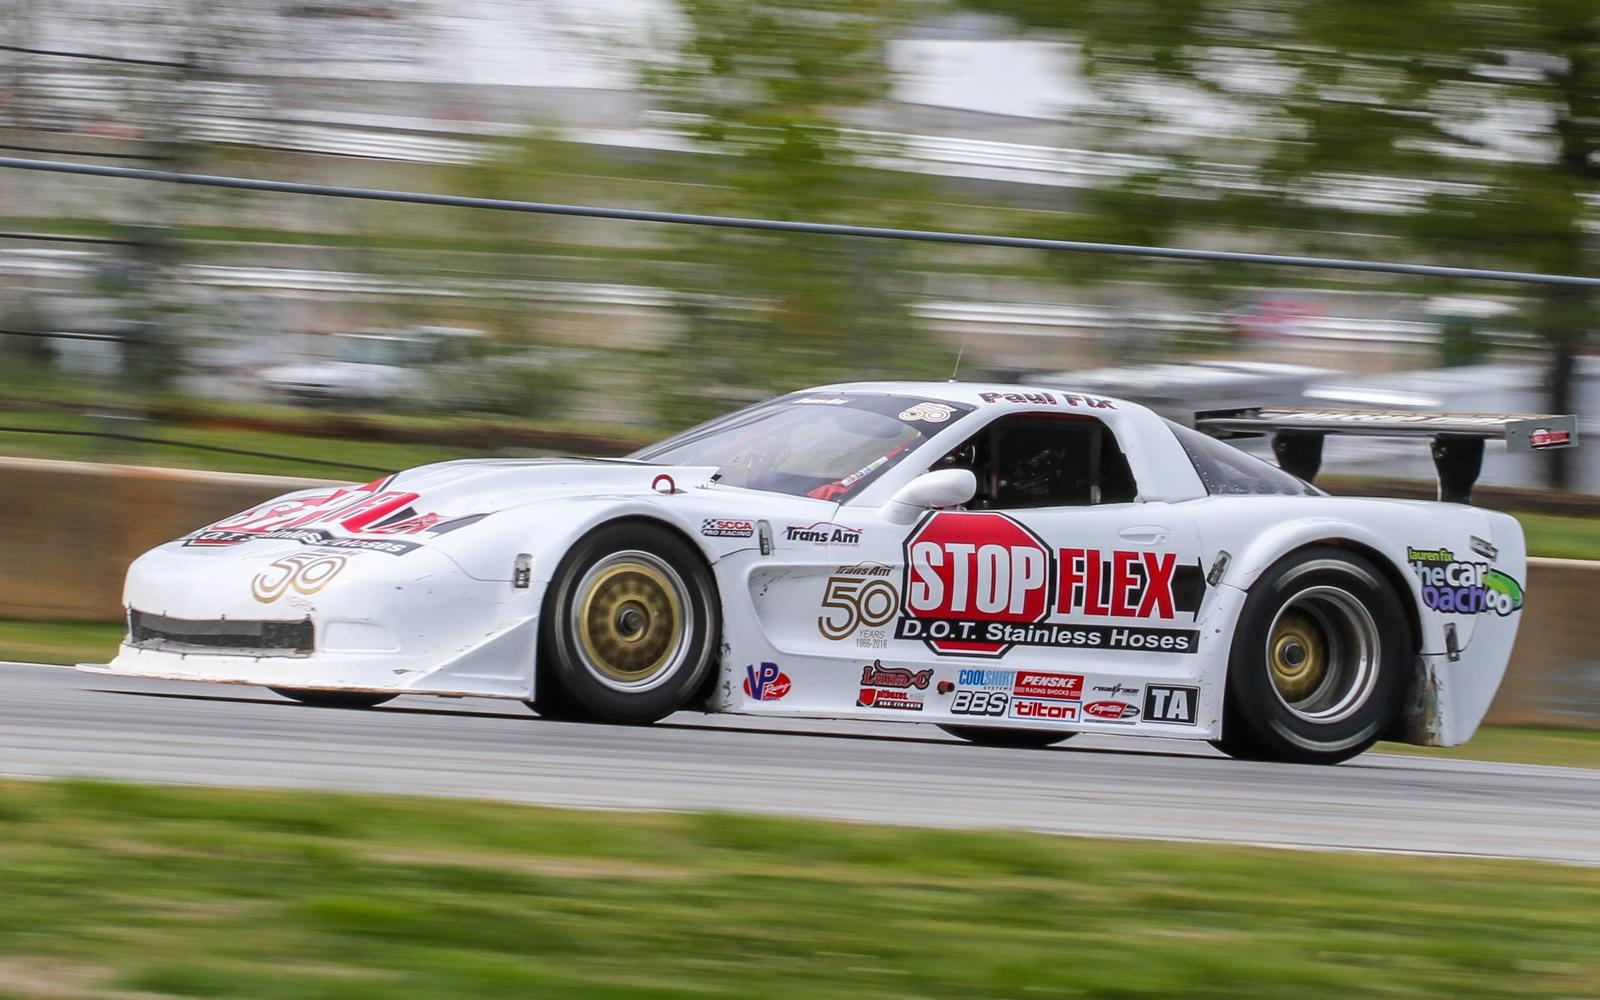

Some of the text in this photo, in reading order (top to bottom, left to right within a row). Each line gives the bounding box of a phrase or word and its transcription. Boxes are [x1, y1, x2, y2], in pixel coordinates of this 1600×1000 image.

[978, 392, 1118, 410] Paul Fix
[716, 520, 752, 530] SCCA
[720, 530, 752, 538] RACING
[787, 526, 859, 543] Trans Am
[252, 551, 347, 604] 50
[835, 564, 891, 577] Trans Am
[911, 541, 1045, 615] STOP
[1057, 548, 1177, 619] FLEX
[818, 576, 900, 641] 50
[859, 630, 885, 639] YEARS
[902, 619, 1190, 649] D.O.T. Stainless Hoses
[856, 638, 888, 649] 1966-2016
[747, 662, 779, 700] VP
[959, 669, 1017, 686] COOLSHIRT
[1021, 675, 1078, 688] PENSKE
[1025, 687, 1046, 695] RACING
[950, 690, 1009, 716] BBS
[1014, 701, 1076, 719] tilton
[1152, 689, 1189, 721] TA
